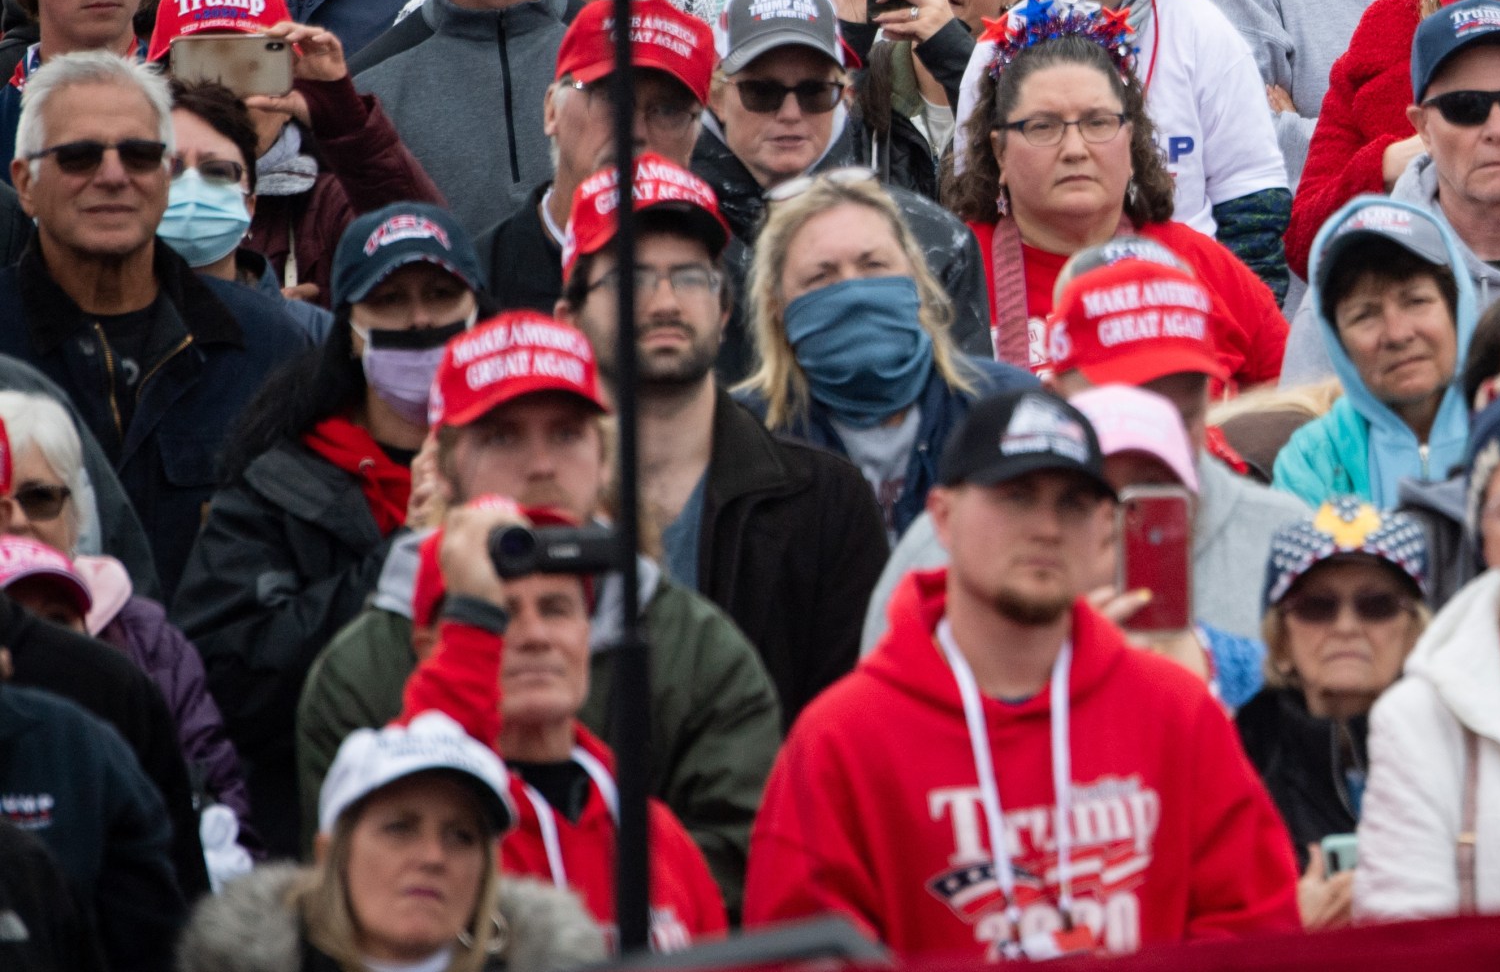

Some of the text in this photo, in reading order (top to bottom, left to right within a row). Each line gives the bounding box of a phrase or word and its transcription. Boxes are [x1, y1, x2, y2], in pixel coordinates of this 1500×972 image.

[748, 0, 819, 17] TRUMP GIRL
[760, 10, 776, 20] GET
[776, 10, 797, 18] OVER
[180, 20, 233, 34] KEEP AMERICA
[642, 15, 698, 47] AMERICA
[654, 33, 692, 59] AGAIN
[595, 182, 652, 215] GRAT
[1081, 279, 1211, 320] MAKE AMERICA
[452, 321, 591, 369] MAKE AMERICA
[1097, 310, 1206, 348] GREAT AGAIN
[466, 349, 585, 391] GREAT AGAIN
[928, 785, 1160, 868] Trump
